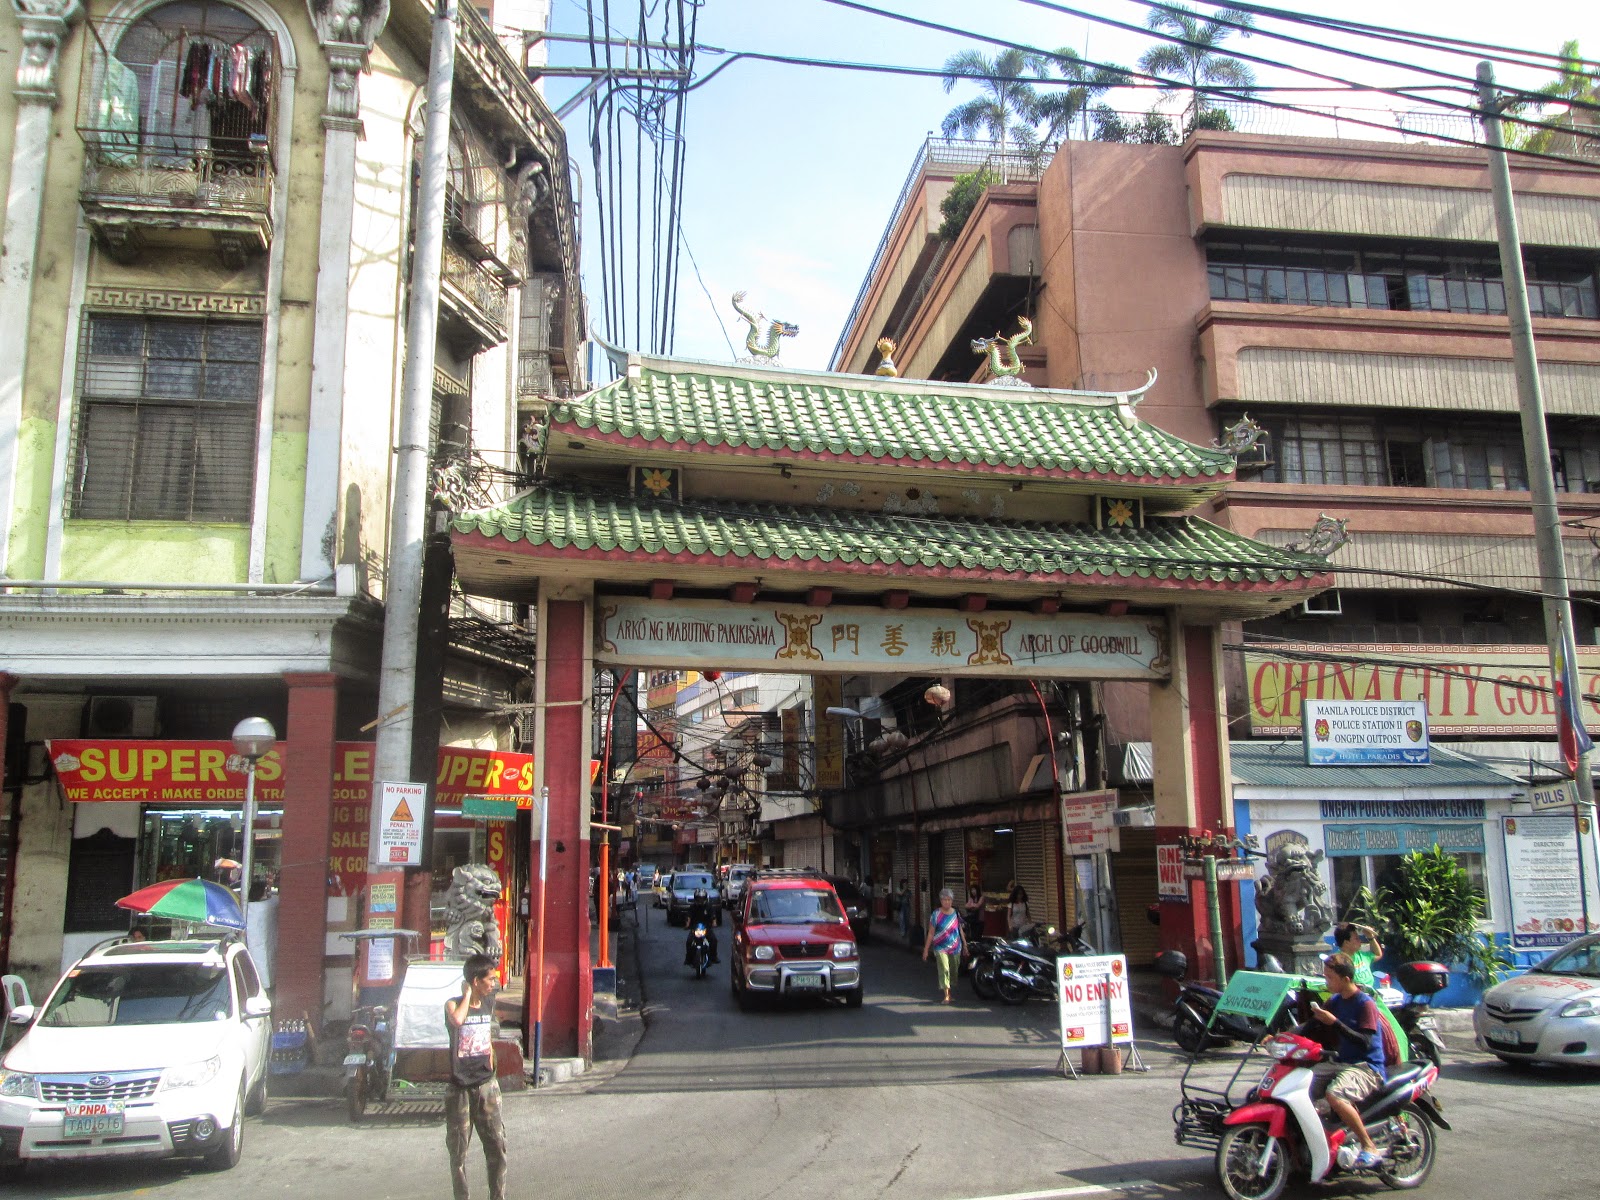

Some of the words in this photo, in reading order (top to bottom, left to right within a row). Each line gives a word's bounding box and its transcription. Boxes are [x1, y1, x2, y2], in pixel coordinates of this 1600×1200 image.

[650, 622, 663, 641] NG
[667, 622, 714, 643] MABUTING
[718, 624, 776, 646] PAKIKISAMA
[1019, 634, 1053, 653] ARCH
[1058, 635, 1076, 653] OF
[1081, 635, 1142, 655] GOODWILL
[1494, 675, 1558, 716] GOL
[1317, 706, 1349, 716] MANILA
[1351, 706, 1378, 716] POLICE
[1380, 706, 1415, 716] DISTRICT
[1332, 720, 1360, 729] POLICE
[1363, 720, 1395, 730] STATION
[1334, 734, 1367, 744] ONGPIN
[1369, 735, 1402, 744] OUTPOST
[79, 748, 228, 782] SUPER
[437, 755, 504, 789] UPER
[67, 788, 89, 799] WE
[93, 788, 149, 799] ACCEPT
[162, 788, 202, 799] MAKE
[333, 788, 367, 799] GOLD
[396, 787, 422, 795] PARKING
[1534, 789, 1565, 805] PULIS
[1322, 800, 1357, 818] ONGPIN
[1359, 800, 1391, 818] POLICE
[1393, 800, 1449, 818] ASSISTANCE
[1450, 800, 1485, 817] CENTER
[332, 831, 369, 848] SALE
[1158, 847, 1181, 864] ONE
[1160, 864, 1183, 884] WAY
[1065, 984, 1083, 1003] NO
[1086, 981, 1122, 1001] ENTRY
[79, 1104, 107, 1115] PNPA
